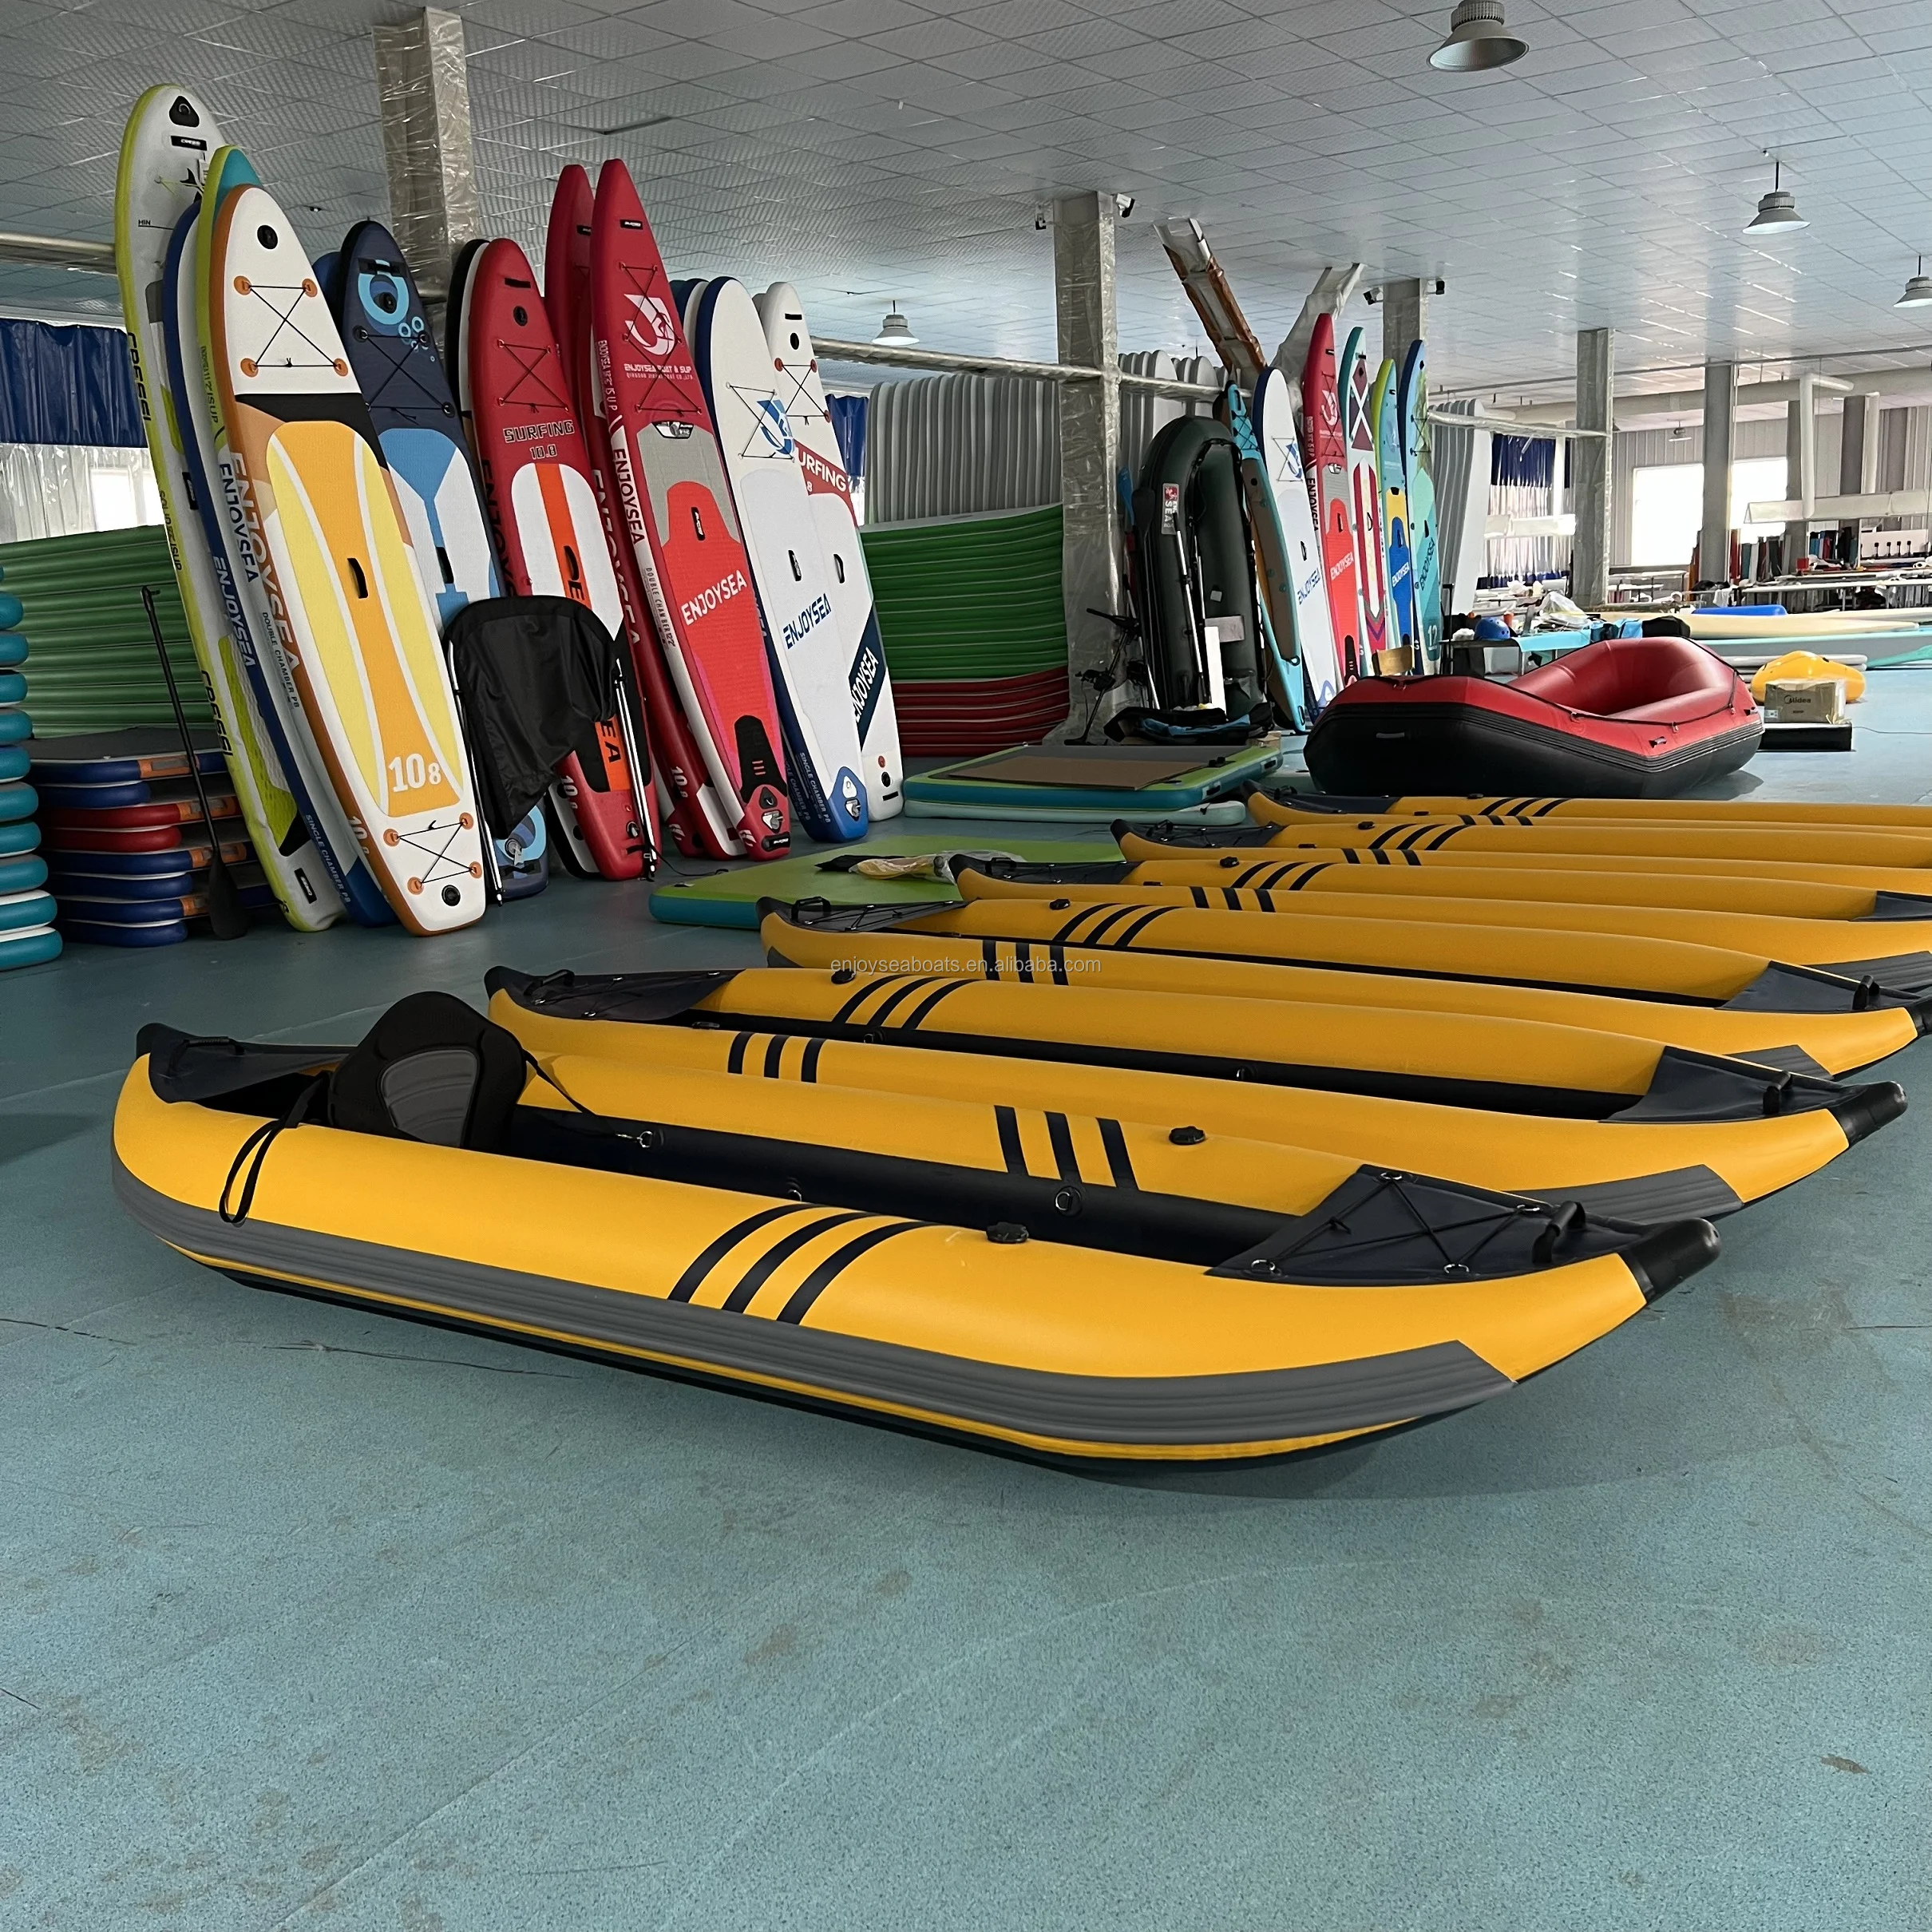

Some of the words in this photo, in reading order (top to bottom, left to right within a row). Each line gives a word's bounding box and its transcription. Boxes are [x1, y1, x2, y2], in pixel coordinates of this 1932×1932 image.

[503, 420, 575, 443] SURFING
[529, 444, 557, 460] 10.8
[613, 449, 645, 544] ENJOYSEA
[798, 451, 847, 492] URFING
[220, 463, 259, 583] ENJOYSEA
[646, 568, 659, 595] DOUBLE
[681, 569, 747, 626] ENJOYSEA
[213, 556, 256, 667] ENJOYSEA
[783, 593, 832, 650] ENJOYSEA
[1427, 624, 1438, 651] 12
[262, 612, 278, 646] DOUBLE
[275, 649, 295, 694] CHAMBER
[1785, 695, 1811, 704] Midea
[799, 752, 813, 779] SINGLE
[810, 780, 825, 813] CHAMBER
[305, 814, 323, 846] SINGLE
[322, 849, 343, 892] CHAMBER
